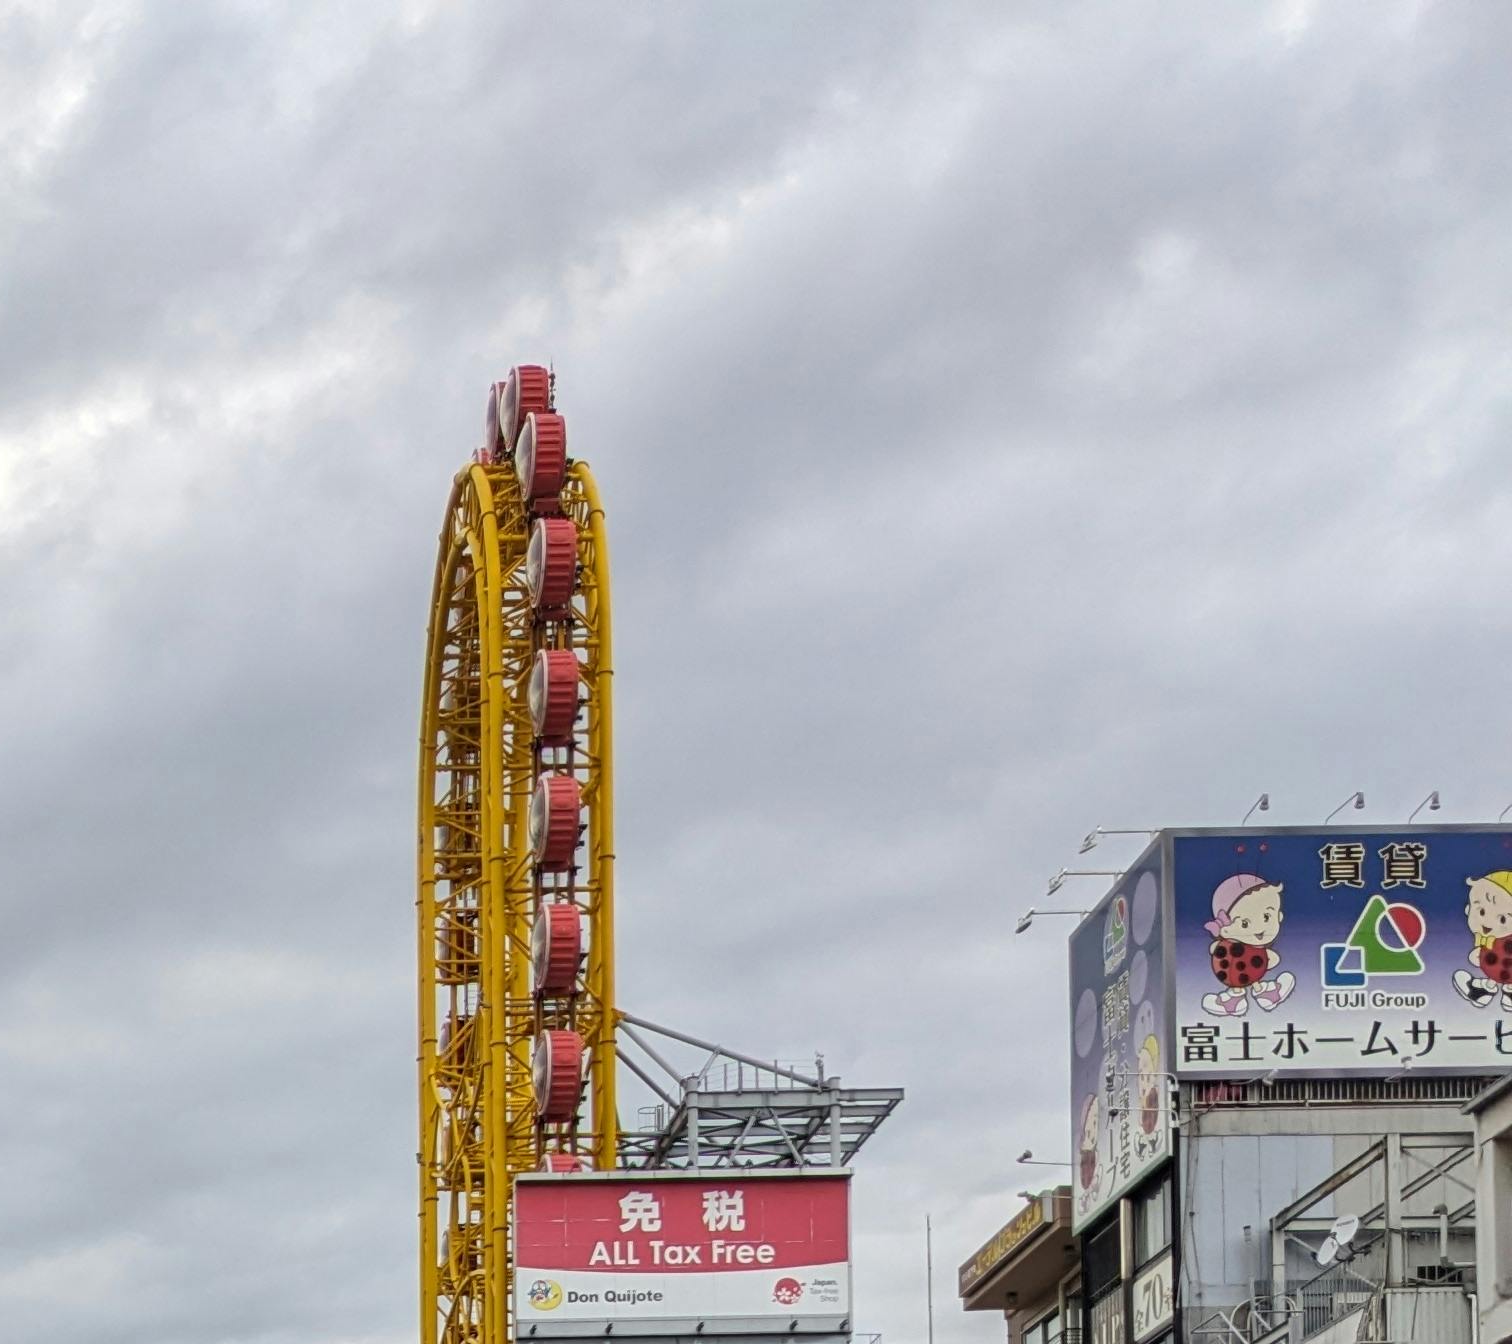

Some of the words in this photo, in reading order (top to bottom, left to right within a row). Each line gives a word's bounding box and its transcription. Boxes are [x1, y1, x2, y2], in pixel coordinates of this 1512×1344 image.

[1318, 842, 1428, 890] 賃貸
[1322, 990, 1366, 1009] FUJI
[1371, 990, 1427, 1010] Group
[588, 1241, 640, 1266] ALL
[650, 1240, 702, 1265] Tax
[711, 1240, 776, 1265] Free
[567, 1290, 599, 1304] Don
[604, 1289, 664, 1305] Quijote
